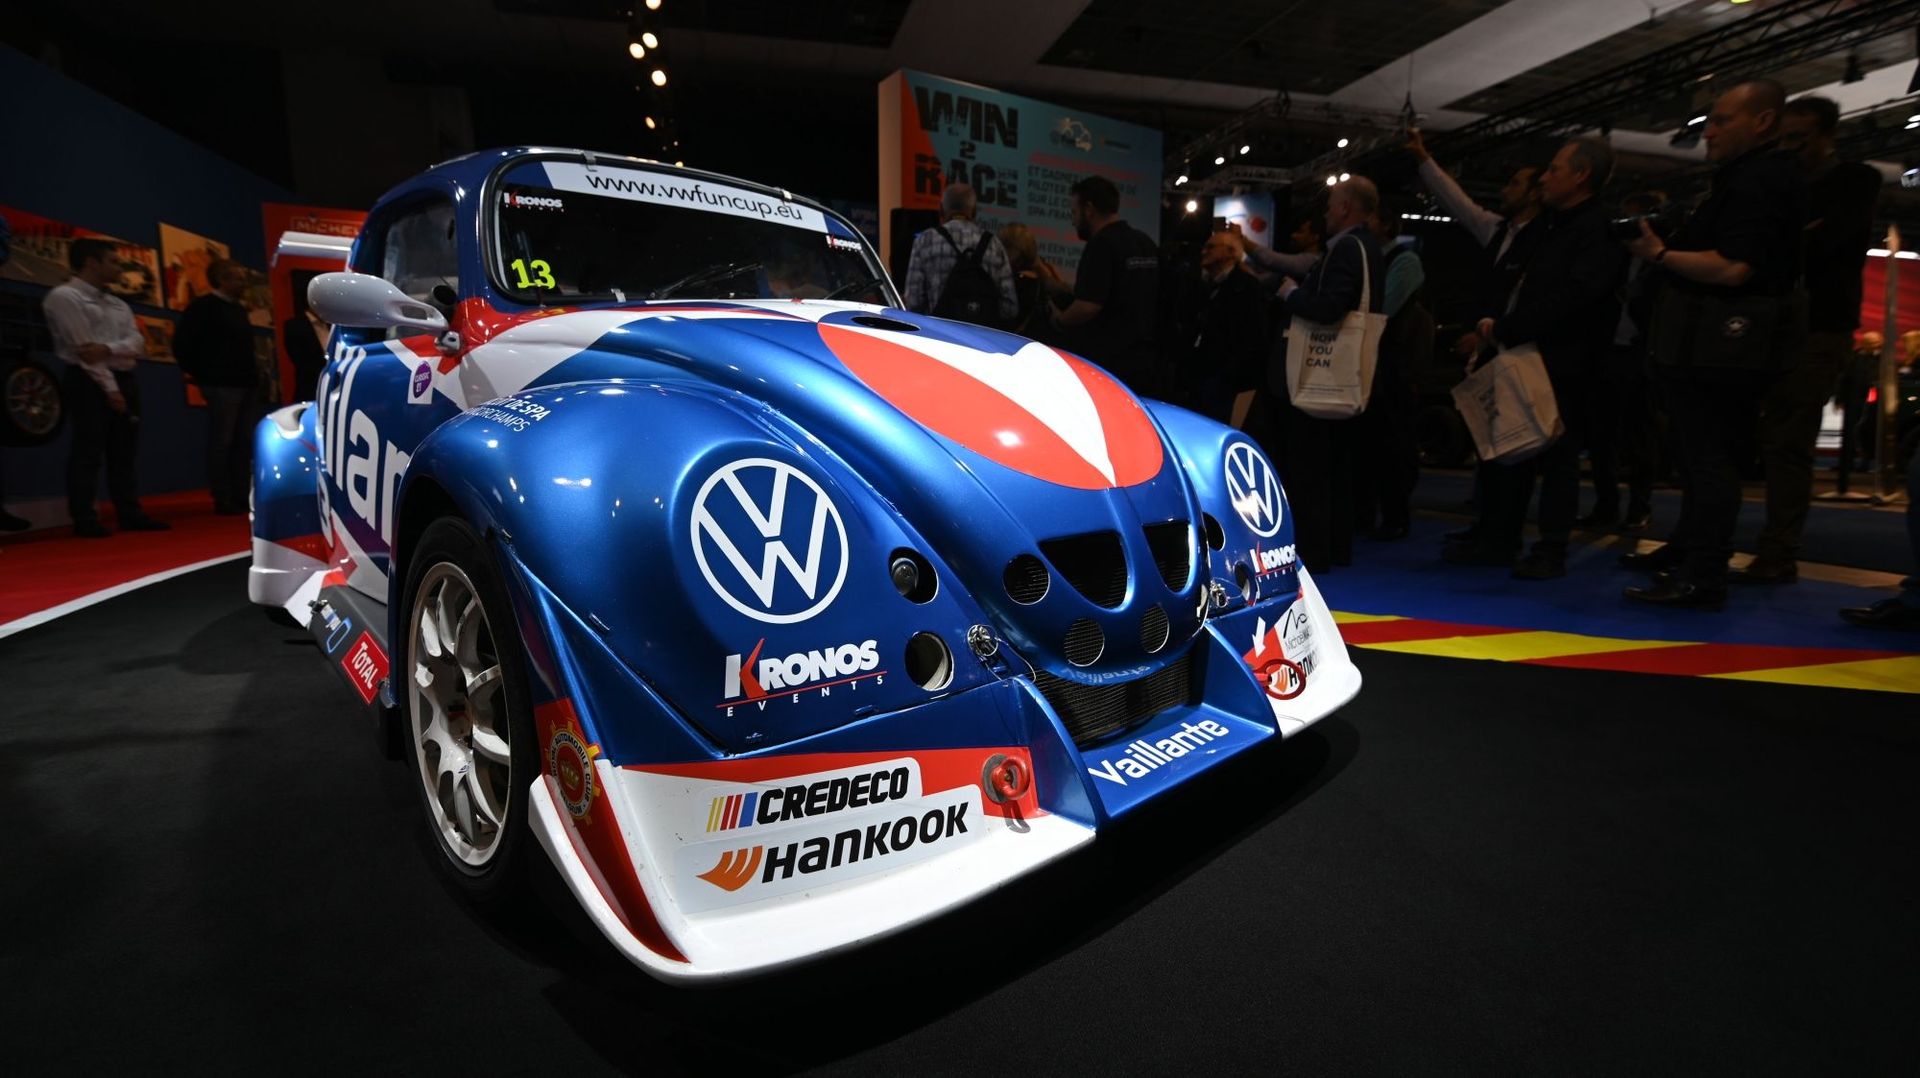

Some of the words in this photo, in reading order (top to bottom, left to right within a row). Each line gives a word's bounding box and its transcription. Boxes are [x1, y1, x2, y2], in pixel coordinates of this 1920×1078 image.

[914, 87, 1018, 148] WIN
[959, 141, 976, 160] 2
[585, 173, 803, 221] www.vwfuncup.eu
[914, 152, 1018, 208] RACE
[1027, 179, 1067, 194] PILOTER
[503, 191, 563, 208] KRONOS
[511, 259, 555, 289] 13
[1308, 345, 1333, 355] YOU
[1309, 331, 1338, 342] NOW
[1306, 358, 1330, 368] CAN
[520, 401, 552, 421] SPA
[1250, 541, 1296, 575] KRONOS
[351, 641, 379, 690] TOTAL
[724, 639, 879, 699] KRONOS
[727, 674, 884, 717] EVENTS
[1088, 719, 1229, 787] Vaillante
[756, 766, 909, 825] CREDECO
